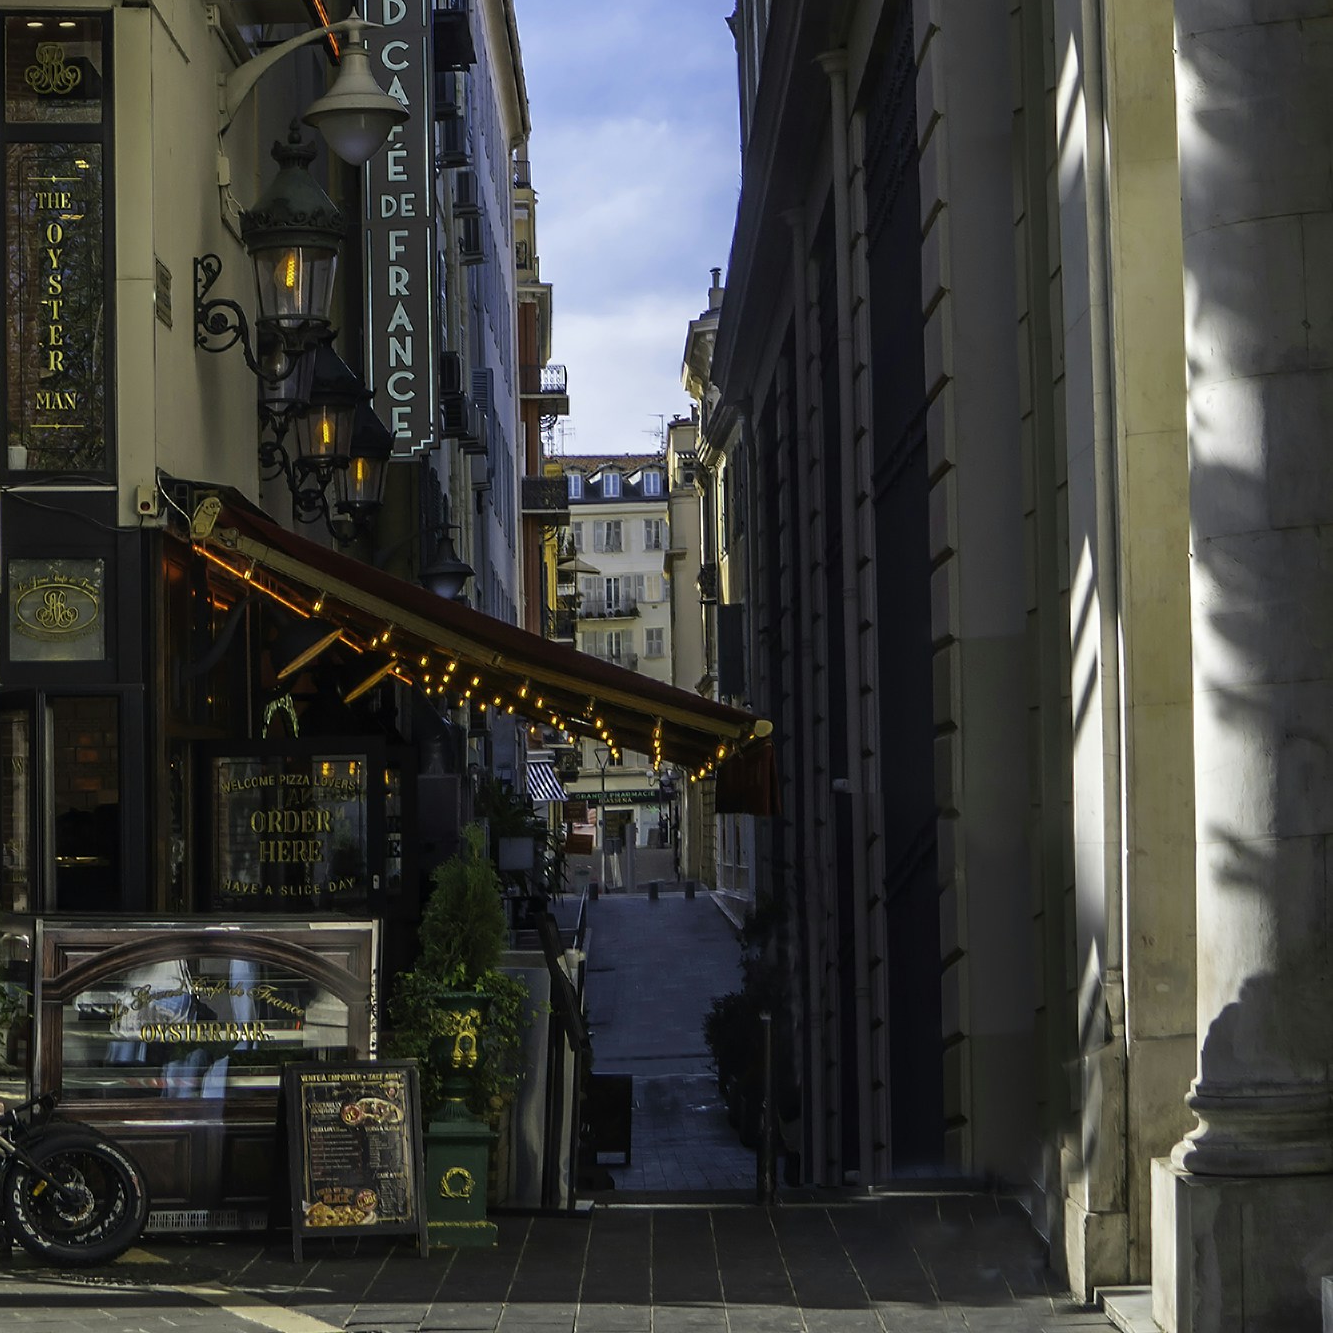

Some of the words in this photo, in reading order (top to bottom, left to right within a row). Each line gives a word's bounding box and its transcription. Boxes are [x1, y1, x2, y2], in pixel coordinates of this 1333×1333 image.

[35, 192, 72, 210] THE
[380, 193, 417, 219] DE
[46, 222, 65, 372] OYSTER
[386, 229, 416, 438] FRANCE
[35, 392, 78, 410] MAN
[221, 775, 275, 794] WELCOME
[279, 774, 310, 786] PIZZA
[314, 776, 357, 790] LOVERS
[250, 809, 334, 833] ORDER
[259, 840, 325, 863] HERE
[223, 878, 258, 894] HAVE
[265, 885, 272, 895] A
[281, 885, 322, 896] SLICE
[329, 878, 355, 892] DAY
[139, 1021, 223, 1043] OYSTER
[225, 1021, 268, 1042] BAR
